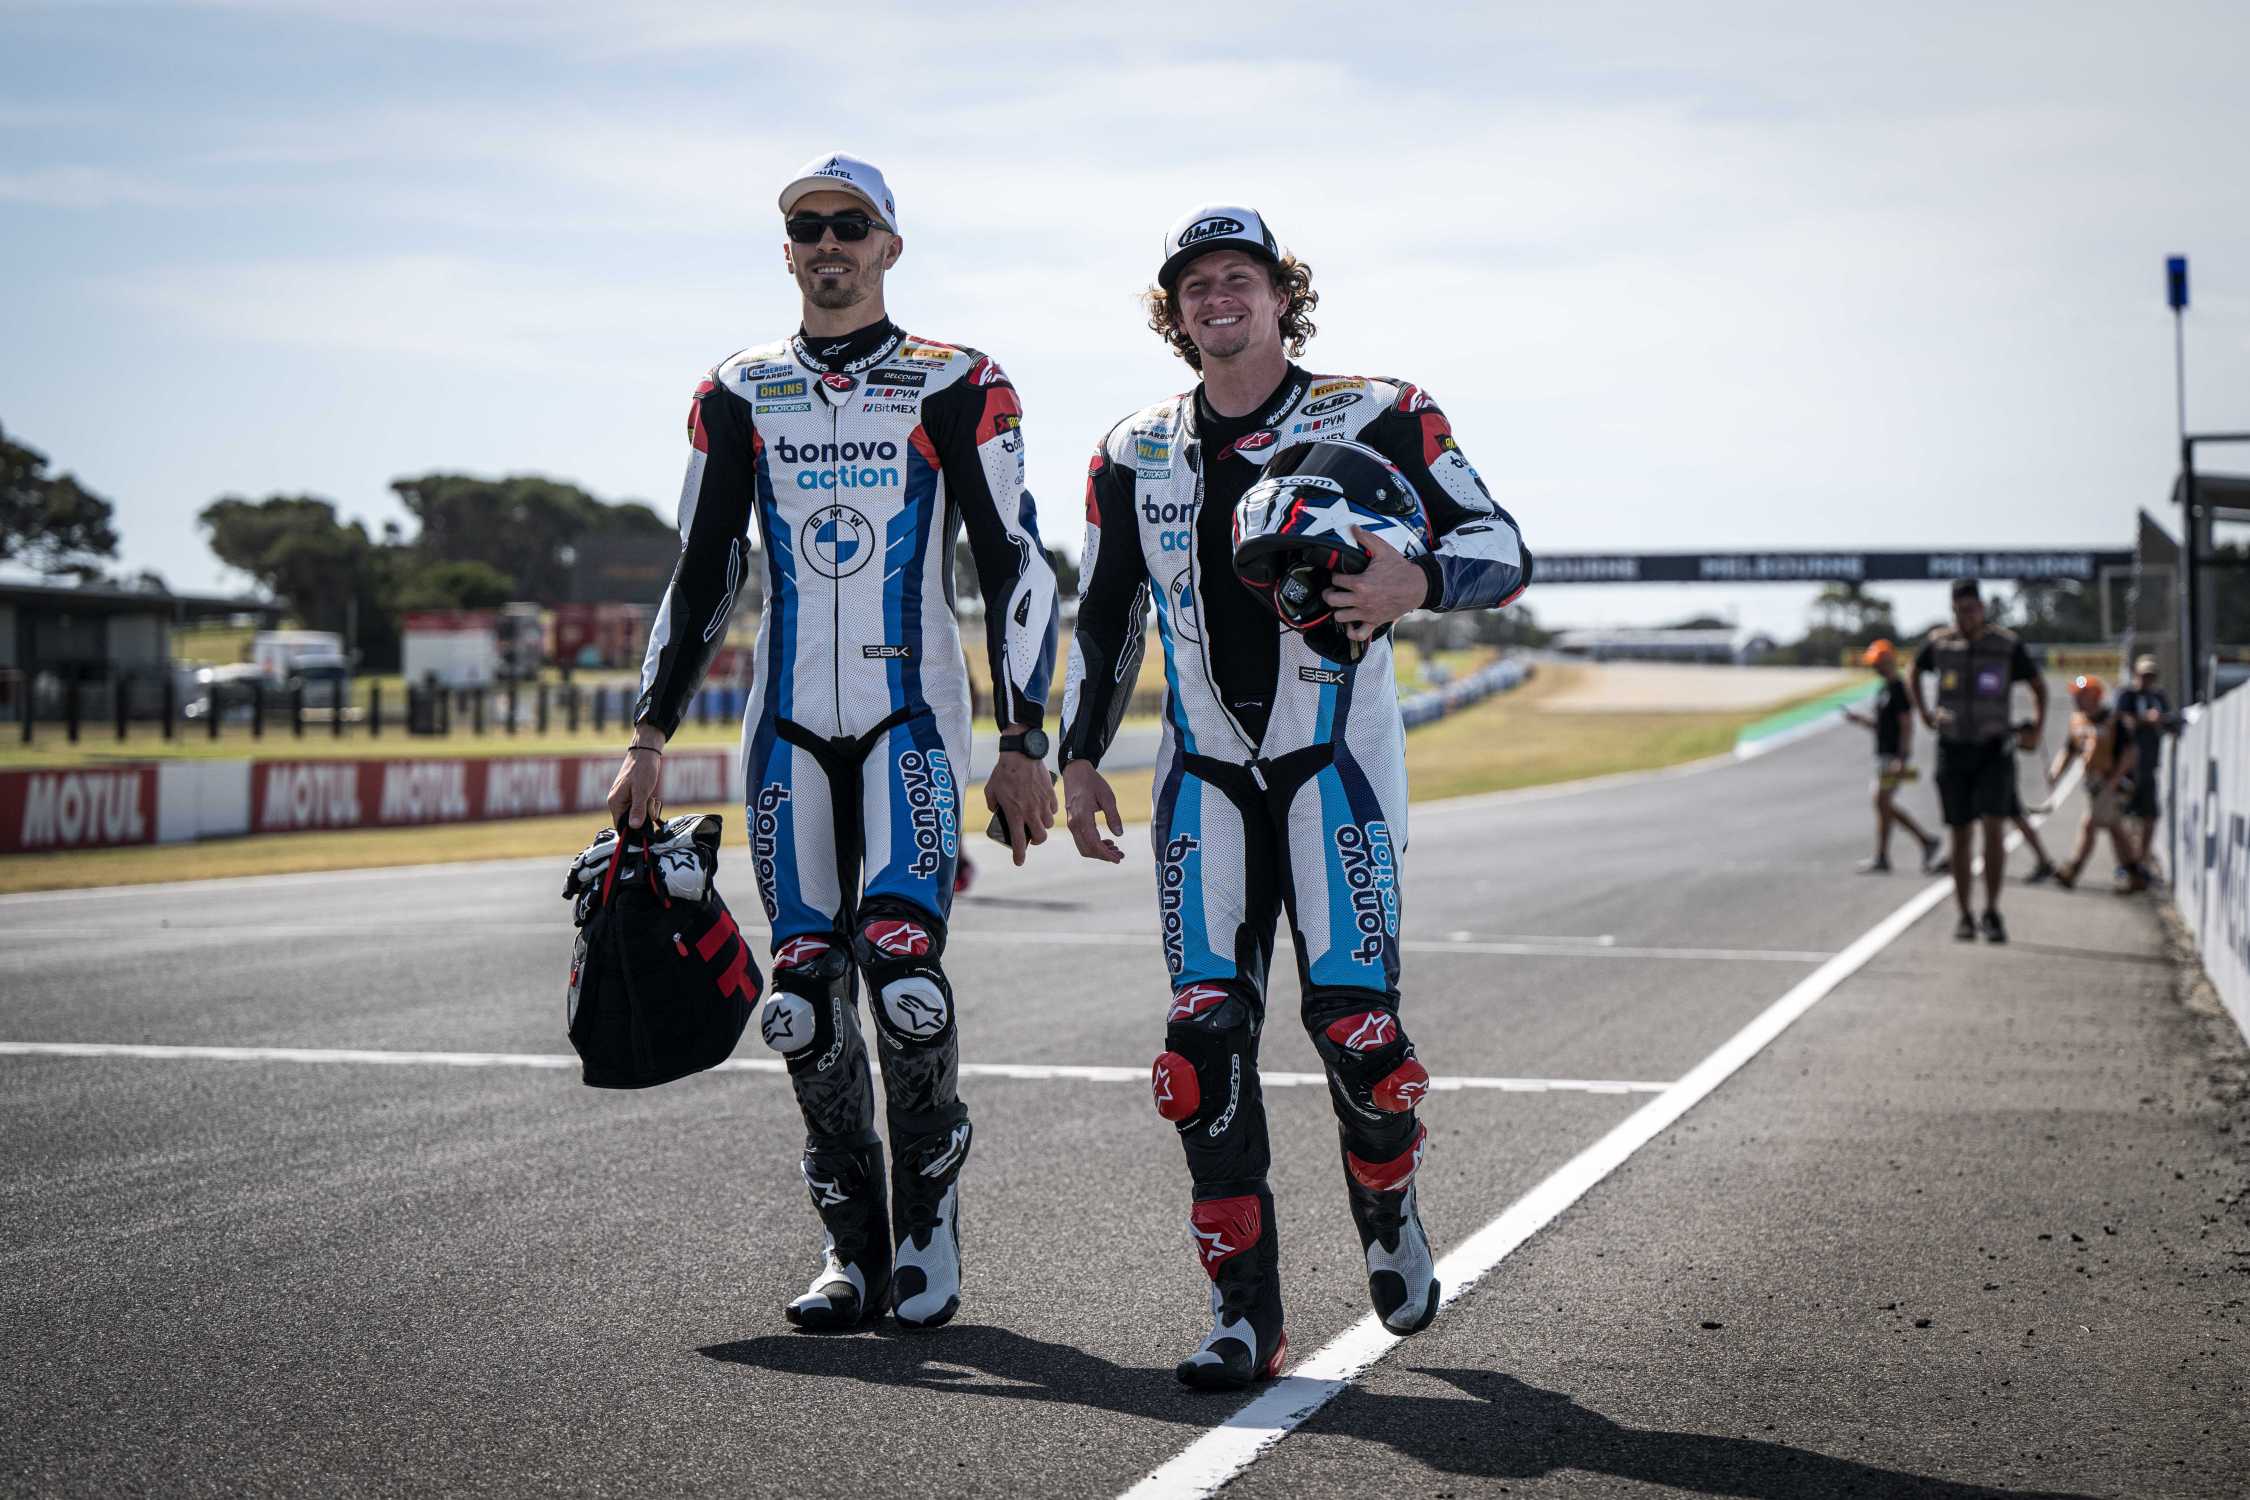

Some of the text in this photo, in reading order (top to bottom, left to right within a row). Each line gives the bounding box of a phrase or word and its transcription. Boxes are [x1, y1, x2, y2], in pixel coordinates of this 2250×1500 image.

[1184, 220, 1235, 243] HJC
[760, 382, 804, 397] ÖHLINS
[883, 371, 923, 382] DELCOURT
[893, 388, 920, 399] PVM
[768, 403, 810, 412] MOTOREX
[874, 403, 917, 415] BitMEX
[1322, 412, 1346, 429] PVM
[775, 436, 897, 463] bonovo
[796, 463, 899, 491] action
[809, 508, 865, 529] BMW
[865, 646, 911, 658] SBK
[1301, 669, 1345, 685] SBK
[262, 765, 362, 828] MOTUL
[379, 760, 468, 821] MOTUL
[484, 758, 561, 816] MOTUL
[21, 772, 146, 845] MOTUL
[899, 751, 939, 879] bonovo
[926, 749, 957, 857] action
[1364, 820, 1398, 938] action
[1163, 832, 1199, 976] bonovo
[1335, 824, 1383, 966] bonovo
